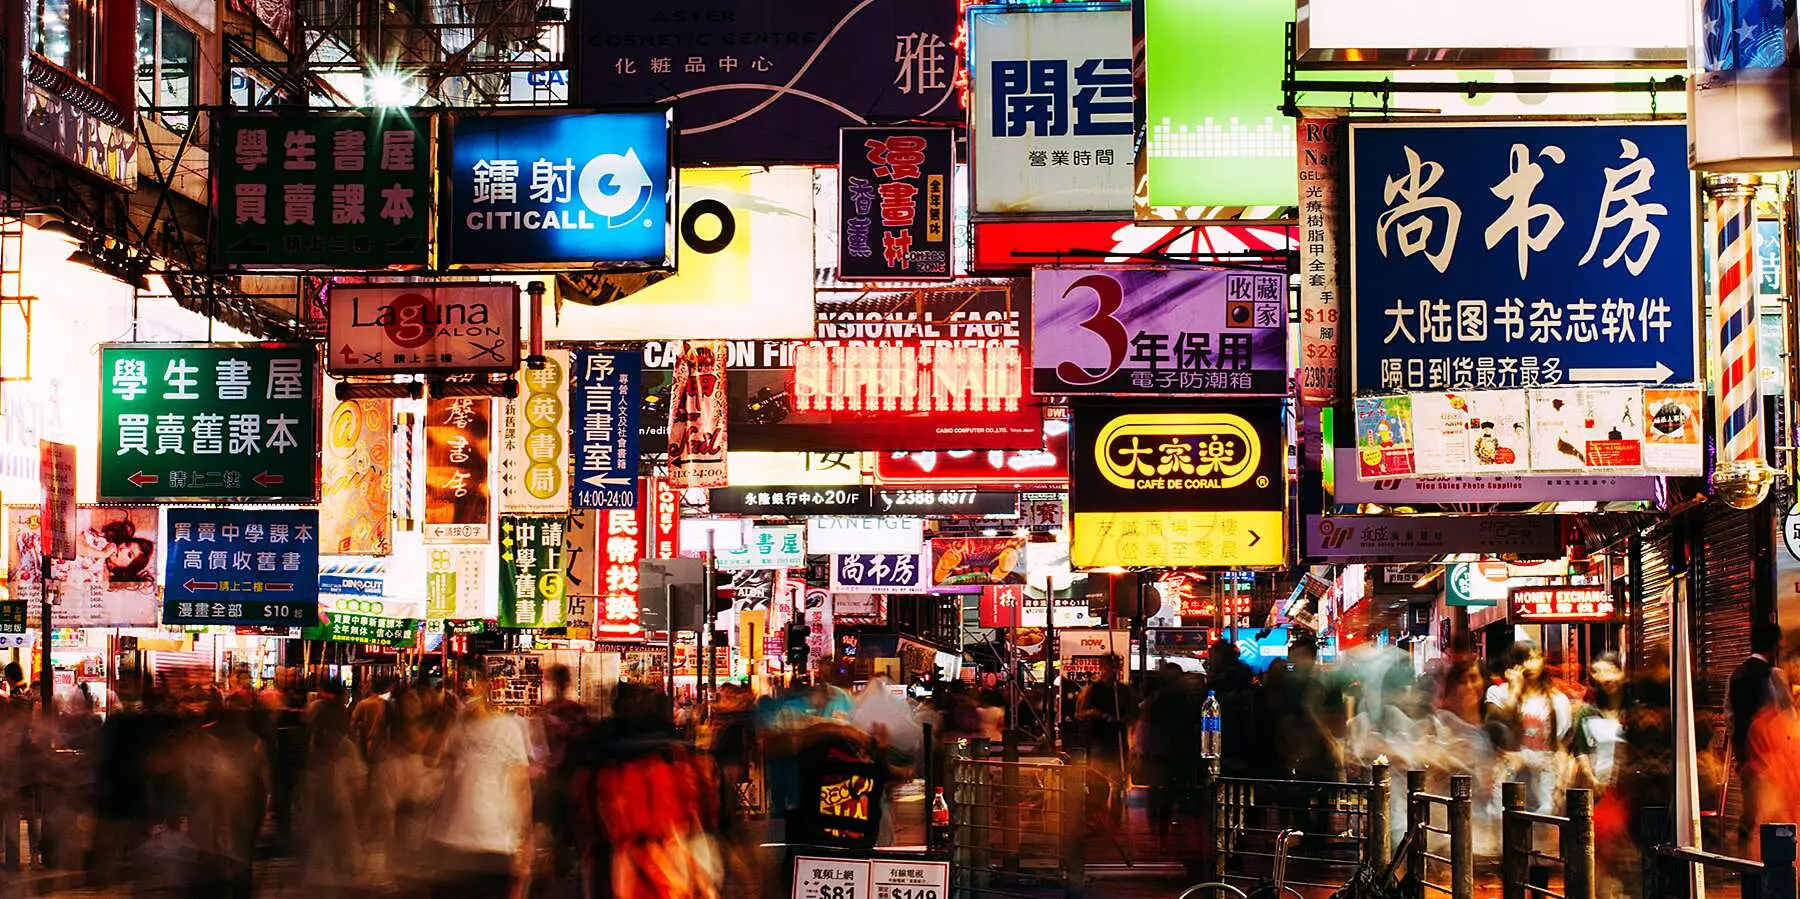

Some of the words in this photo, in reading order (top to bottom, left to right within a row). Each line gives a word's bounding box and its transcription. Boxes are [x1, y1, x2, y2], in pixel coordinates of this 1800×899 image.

[650, 10, 737, 22] ASTER
[589, 33, 710, 47] COSMETIC
[722, 32, 815, 45] CENTRE
[615, 55, 774, 74] 化粧品中心
[894, 31, 945, 96] 雅
[235, 129, 416, 171] 學生書屋
[1029, 150, 1114, 167] 營業時間
[472, 157, 576, 204] 鐳射
[235, 183, 415, 226] 買賣課本
[1376, 138, 1669, 281] 尚书房
[466, 210, 595, 231] CITICALL
[1306, 185, 1326, 287] 光療樹脂甲全套
[904, 250, 945, 262] COMICS
[917, 262, 946, 273] ZONE
[1320, 291, 1334, 304] 手
[352, 297, 489, 341] Laguna
[950, 311, 1020, 338] FACE
[1383, 297, 1672, 344] 大陆图书杂志软件
[425, 327, 501, 337] SALON
[112, 358, 303, 401] 學生書屋
[795, 368, 918, 398] SUPER
[1131, 371, 1252, 389] 電子防潮箱
[1304, 366, 1327, 388] 2396
[1381, 357, 1564, 388] 隔日到货最齐最多
[582, 352, 616, 472] 序言書室
[117, 413, 299, 457] 買賣舊課本
[530, 361, 557, 494] 華英書局
[169, 471, 241, 490] 請上二樓
[1136, 477, 1165, 489] CAFÉ
[1167, 479, 1183, 489] DE
[1184, 479, 1221, 490] CORAL
[1438, 482, 1460, 490] Shing
[578, 489, 634, 508] 14:00-24:00
[174, 522, 313, 544] 買賣中學課本
[729, 533, 800, 555] 書屋
[183, 550, 302, 572] 高價收舊書
[605, 508, 639, 620] 民幣找換
[514, 522, 537, 624] 中學舊書
[218, 580, 264, 593] 請上二樓
[1514, 591, 1553, 604] MONEY
[178, 602, 243, 618] 漫畫全部
[263, 605, 290, 618] $10
[1081, 639, 1102, 647] now
